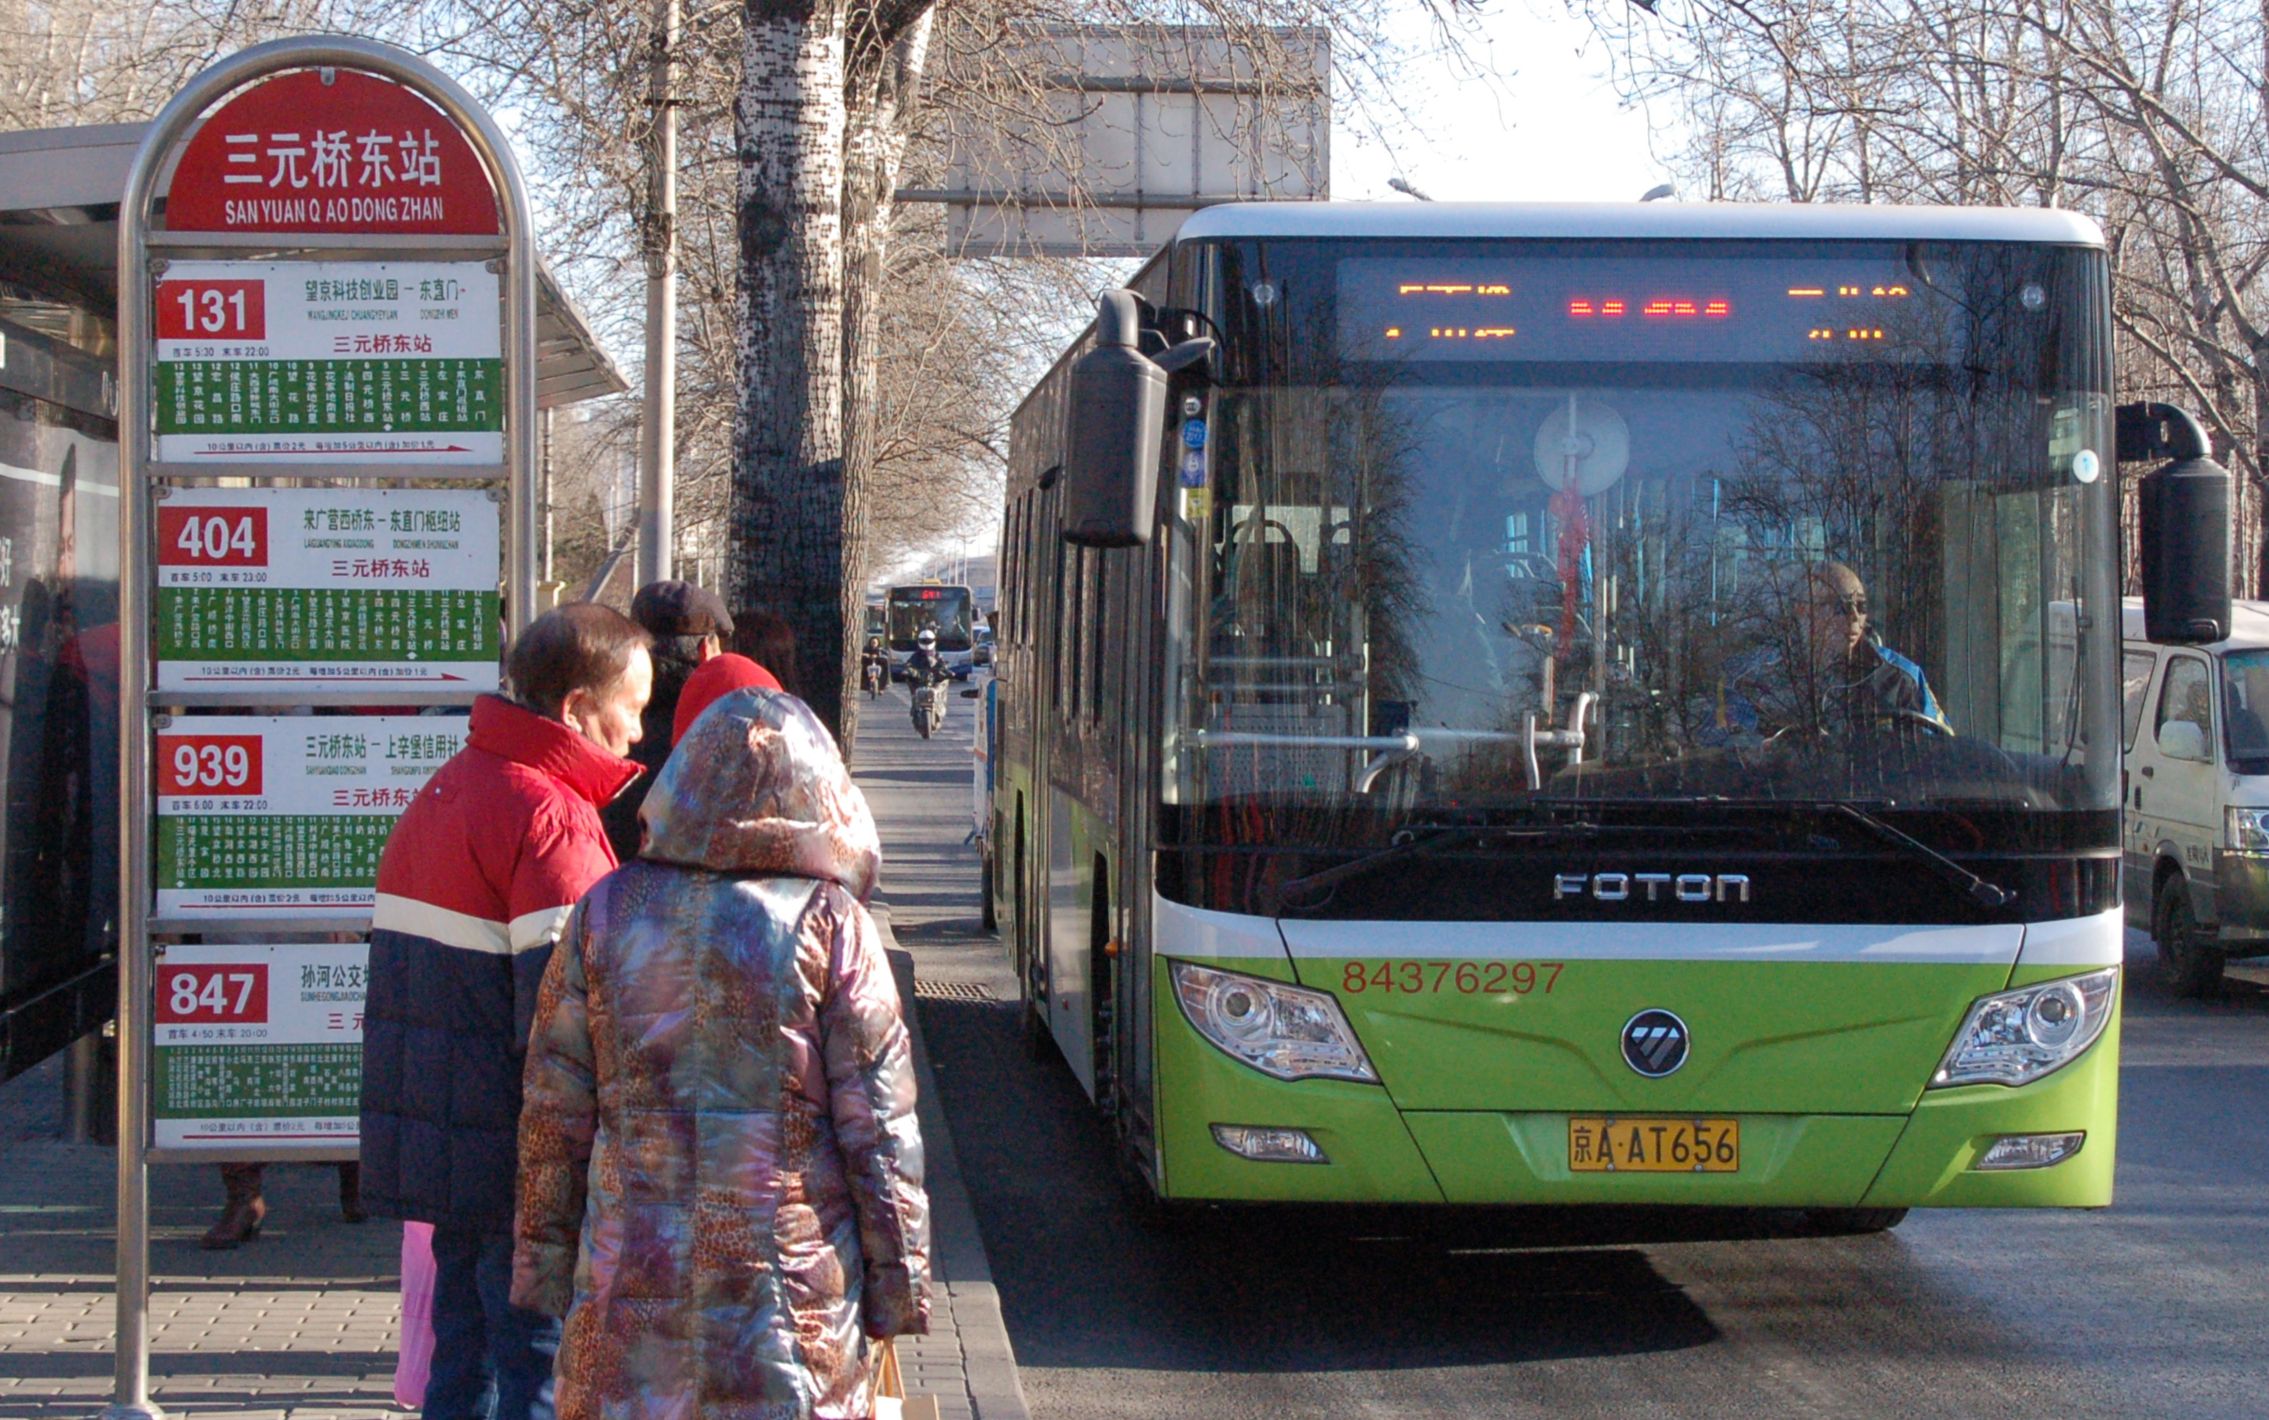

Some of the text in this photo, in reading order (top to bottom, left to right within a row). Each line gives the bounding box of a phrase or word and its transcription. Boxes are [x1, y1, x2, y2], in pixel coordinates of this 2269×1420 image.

[224, 129, 440, 188] 三元桥东站
[226, 200, 258, 224] SAN
[261, 199, 305, 223] YUAN
[352, 198, 397, 222] DONG
[401, 197, 443, 220] ZHAN
[178, 289, 245, 332] 131
[306, 279, 458, 301] 望京科技创业园 东直门
[334, 334, 431, 353] 三元桥东站
[307, 371, 317, 423] 花家地北里
[362, 371, 374, 422] 四元桥西
[382, 371, 393, 422] 三元桥东站
[400, 371, 411, 422] 三元桥
[419, 371, 430, 421] 三元桥西站
[475, 370, 486, 420] 东直门
[178, 516, 255, 558] 404
[304, 509, 460, 532] 来广营西桥东 东直门枢纽站
[332, 559, 429, 577] 三元桥东站
[175, 745, 248, 786] 939
[306, 734, 366, 758] 三元桥东站
[332, 788, 422, 808] 三元桥东
[1554, 873, 1749, 901] FOTON
[171, 973, 254, 1014] 847
[1342, 961, 1565, 994] 84376297
